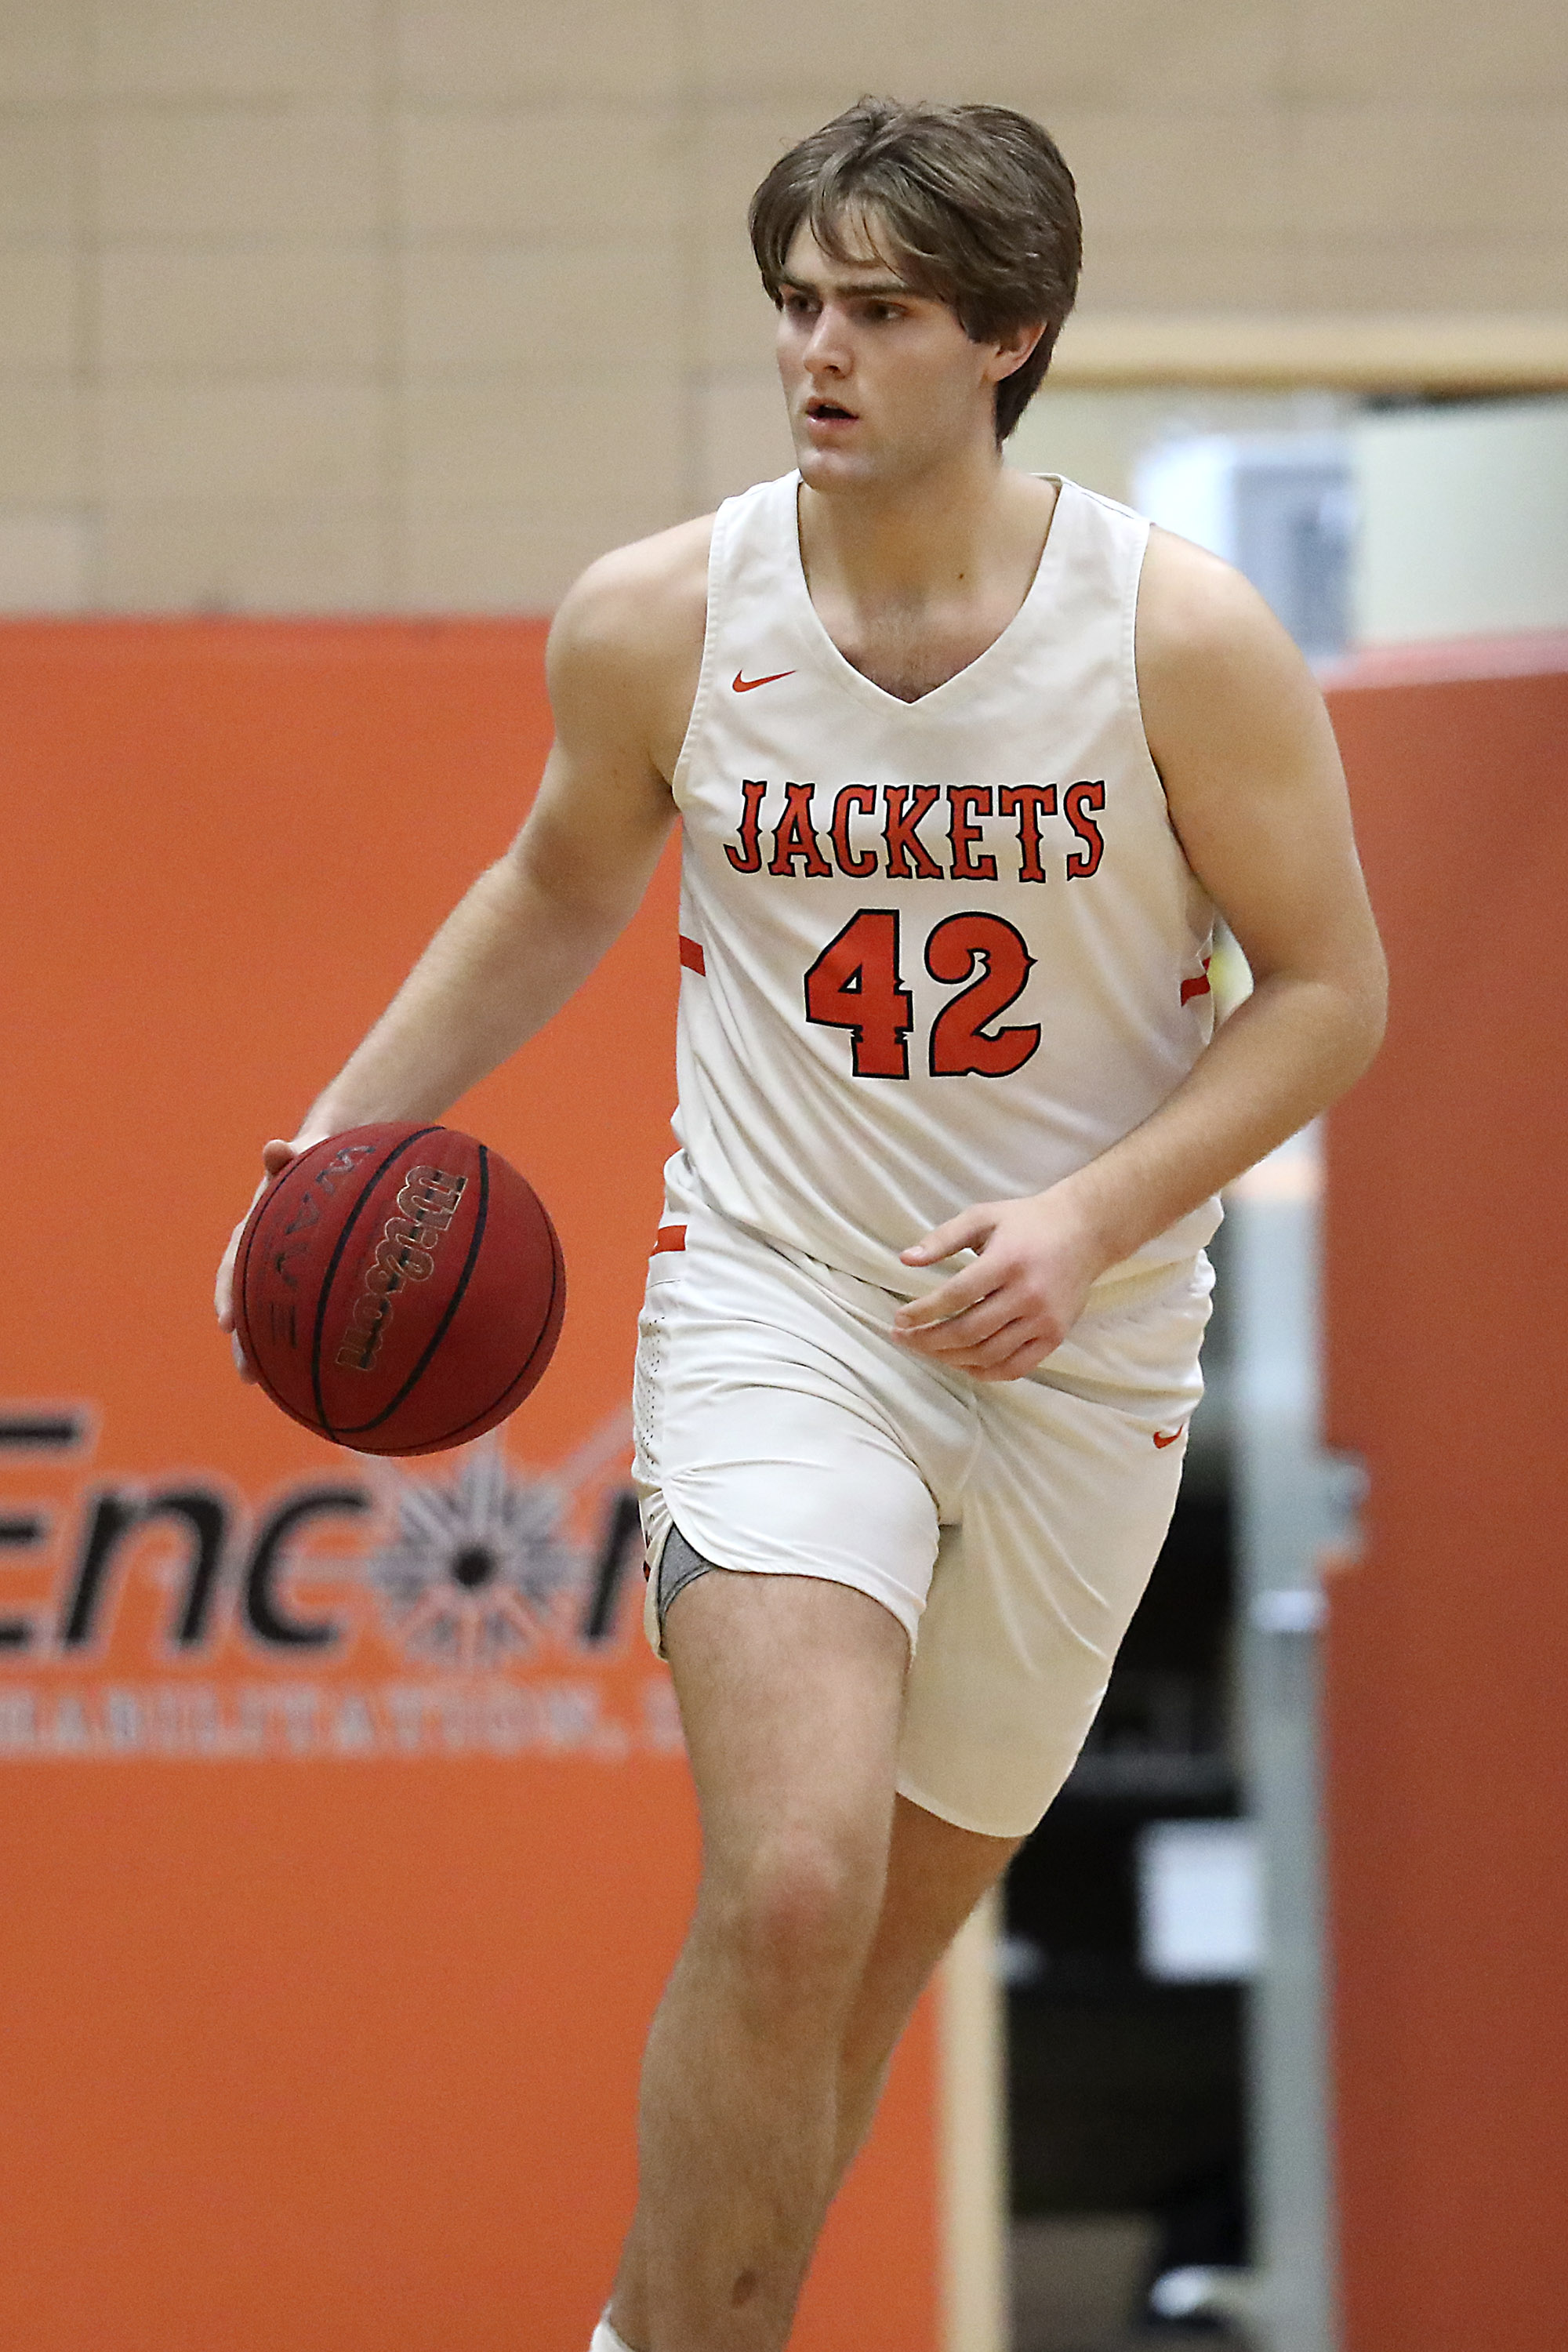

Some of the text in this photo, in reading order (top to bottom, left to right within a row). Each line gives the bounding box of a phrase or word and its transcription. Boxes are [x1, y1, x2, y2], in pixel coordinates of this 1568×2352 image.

[723, 779, 1105, 884] JACKETS
[804, 908, 1042, 1080] 42
[336, 1165, 469, 1371] Wilson
